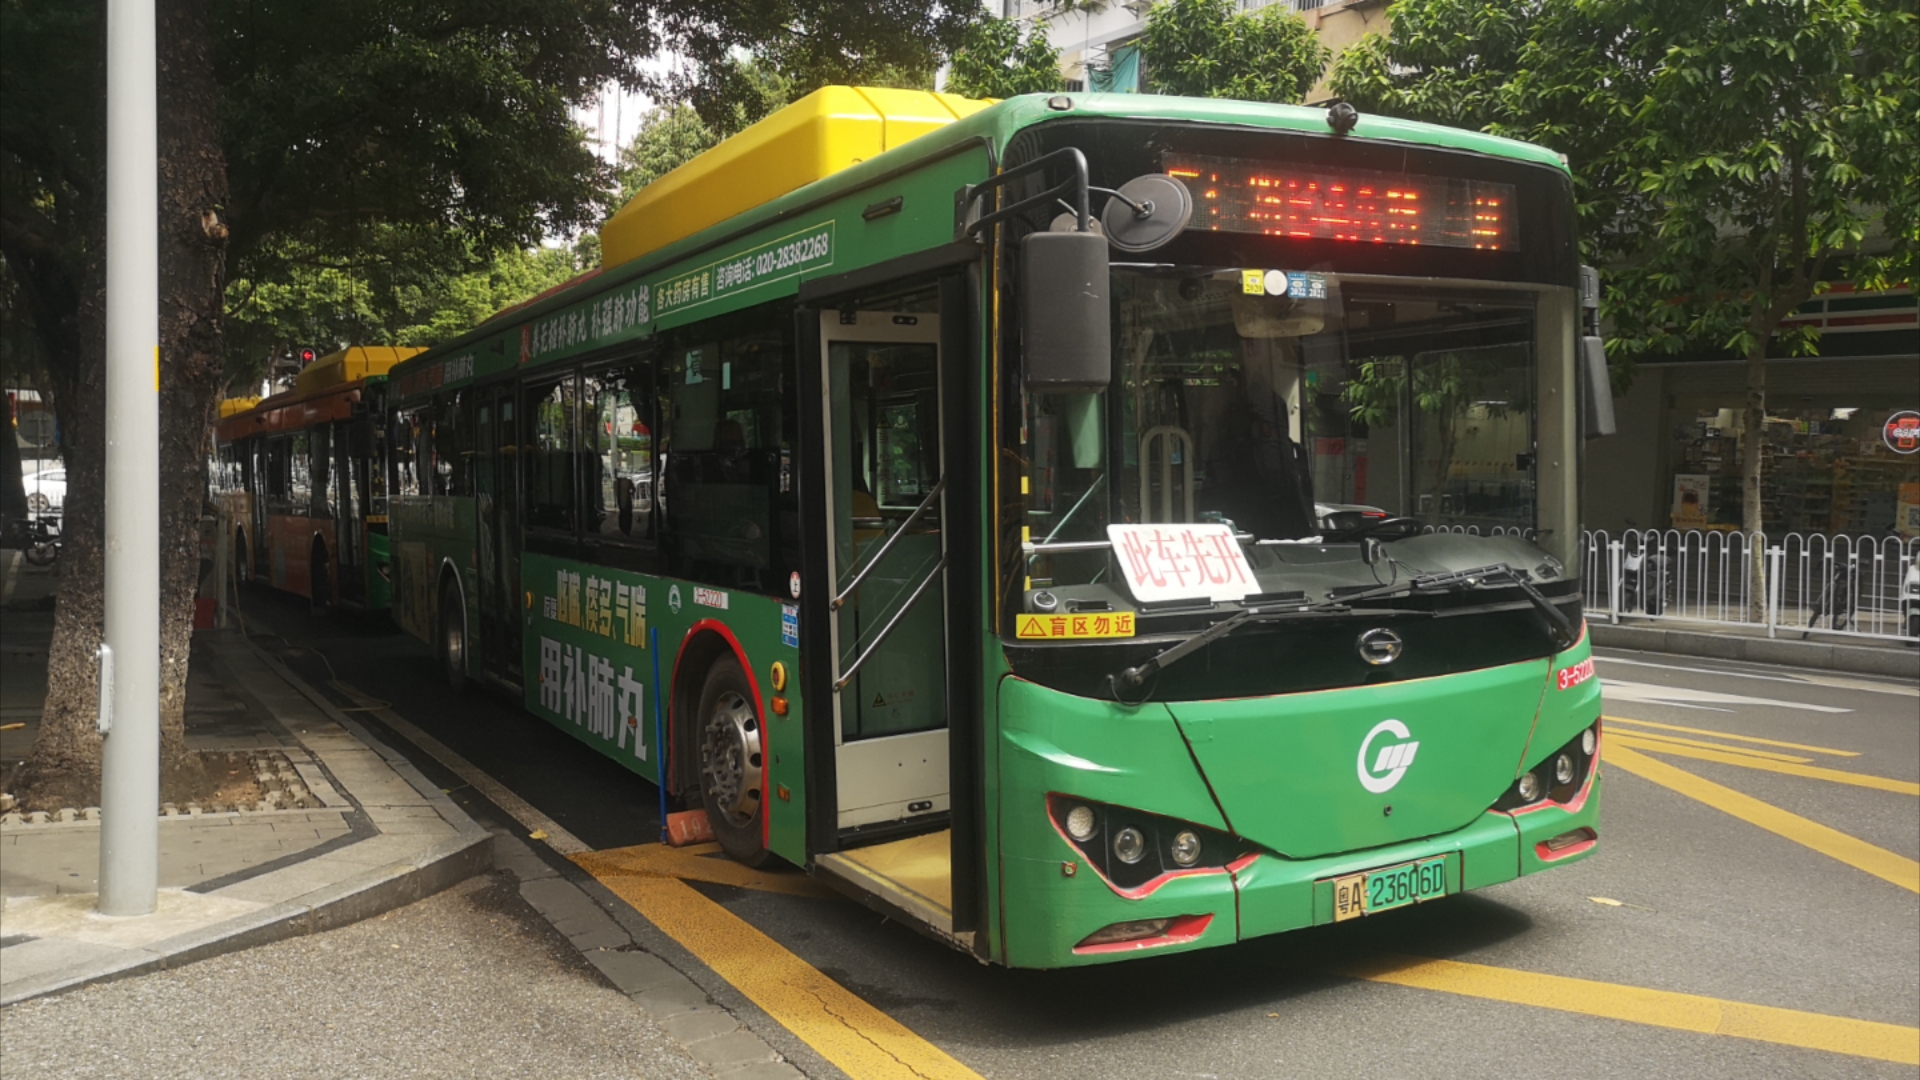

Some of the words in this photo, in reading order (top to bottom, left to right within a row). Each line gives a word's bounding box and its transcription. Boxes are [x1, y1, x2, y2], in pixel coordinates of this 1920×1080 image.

[656, 271, 710, 311] 各大药房有售
[1122, 528, 1247, 588] 此车先开
[1049, 614, 1132, 638] 盲区勿近
[540, 635, 647, 761] 用补肺丸
